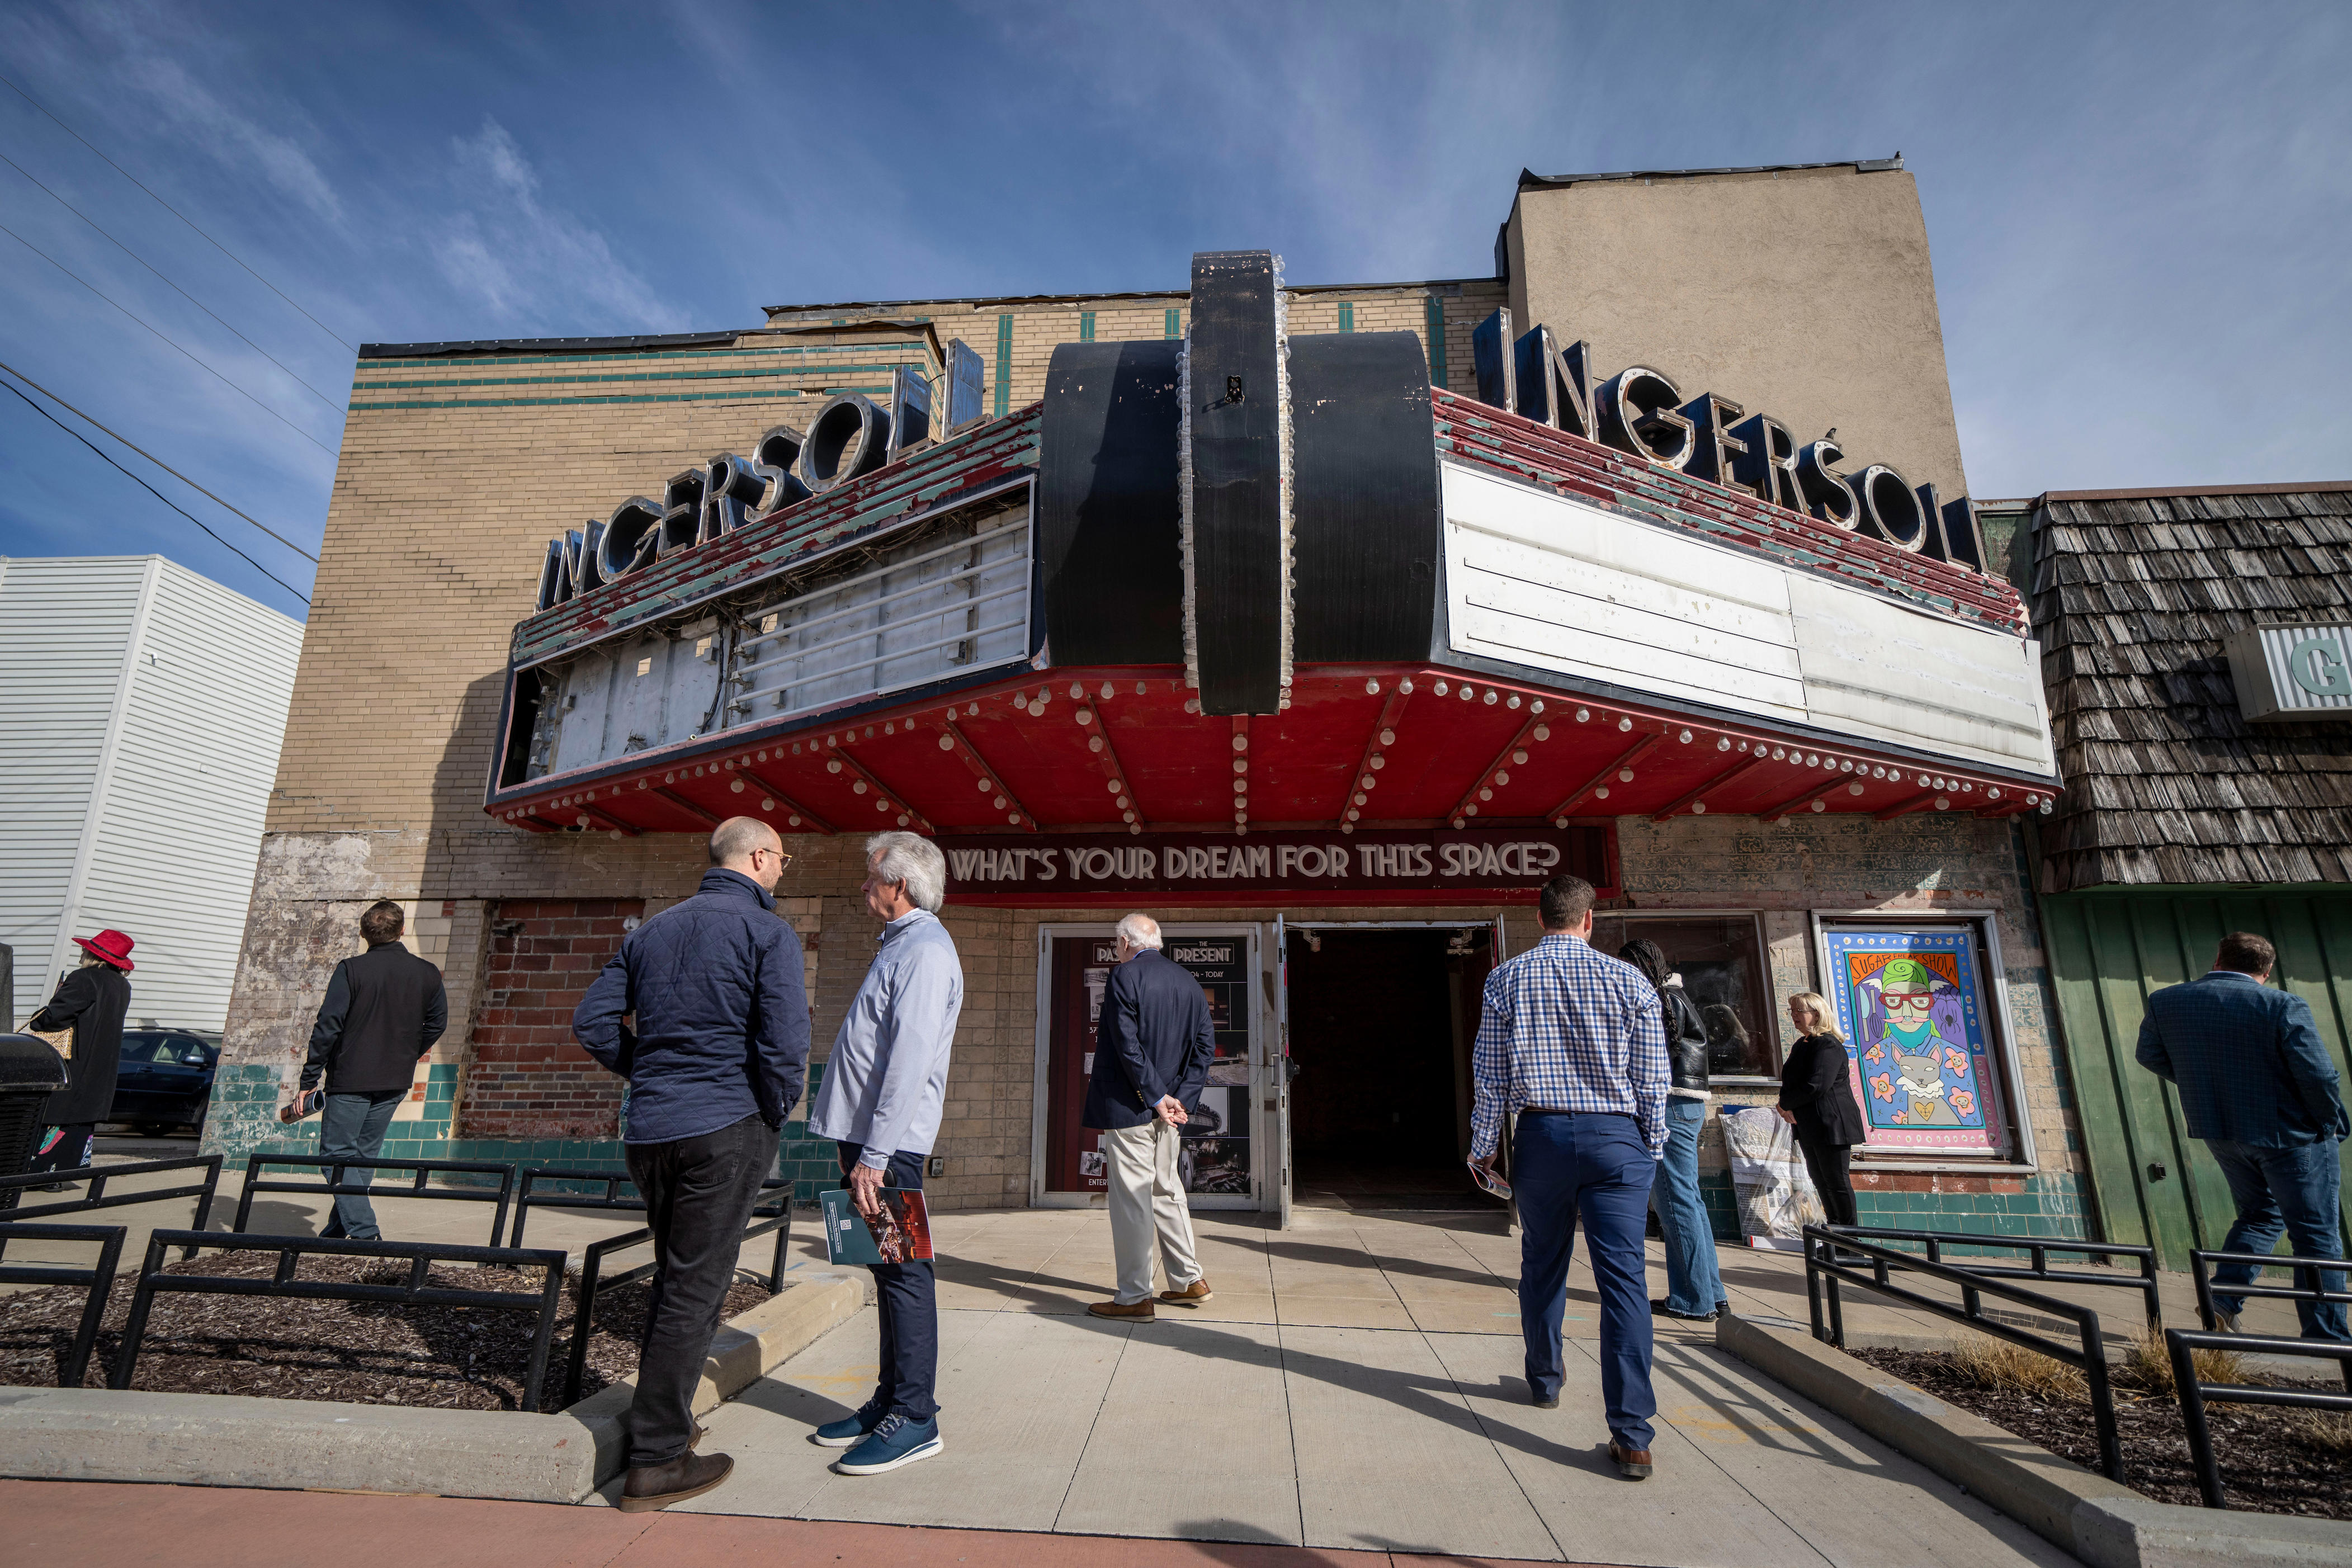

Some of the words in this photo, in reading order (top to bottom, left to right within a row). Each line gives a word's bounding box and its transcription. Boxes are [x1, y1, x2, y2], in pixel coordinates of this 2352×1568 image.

[1473, 306, 2011, 583] INGERSOLL
[533, 337, 994, 613] INGERSOLL
[947, 848, 1057, 881] WHAT'S
[1063, 847, 1156, 880] YOUR
[1164, 845, 1271, 879] DREAM
[1276, 844, 1349, 877] FOR
[1356, 843, 1433, 877] THIS
[1439, 842, 1560, 876] SPACE?
[1174, 948, 1231, 962] PRESENT
[1850, 953, 1892, 979] SUGAR
[1893, 953, 1919, 962] FREAK
[1922, 954, 1957, 979] SHOW
